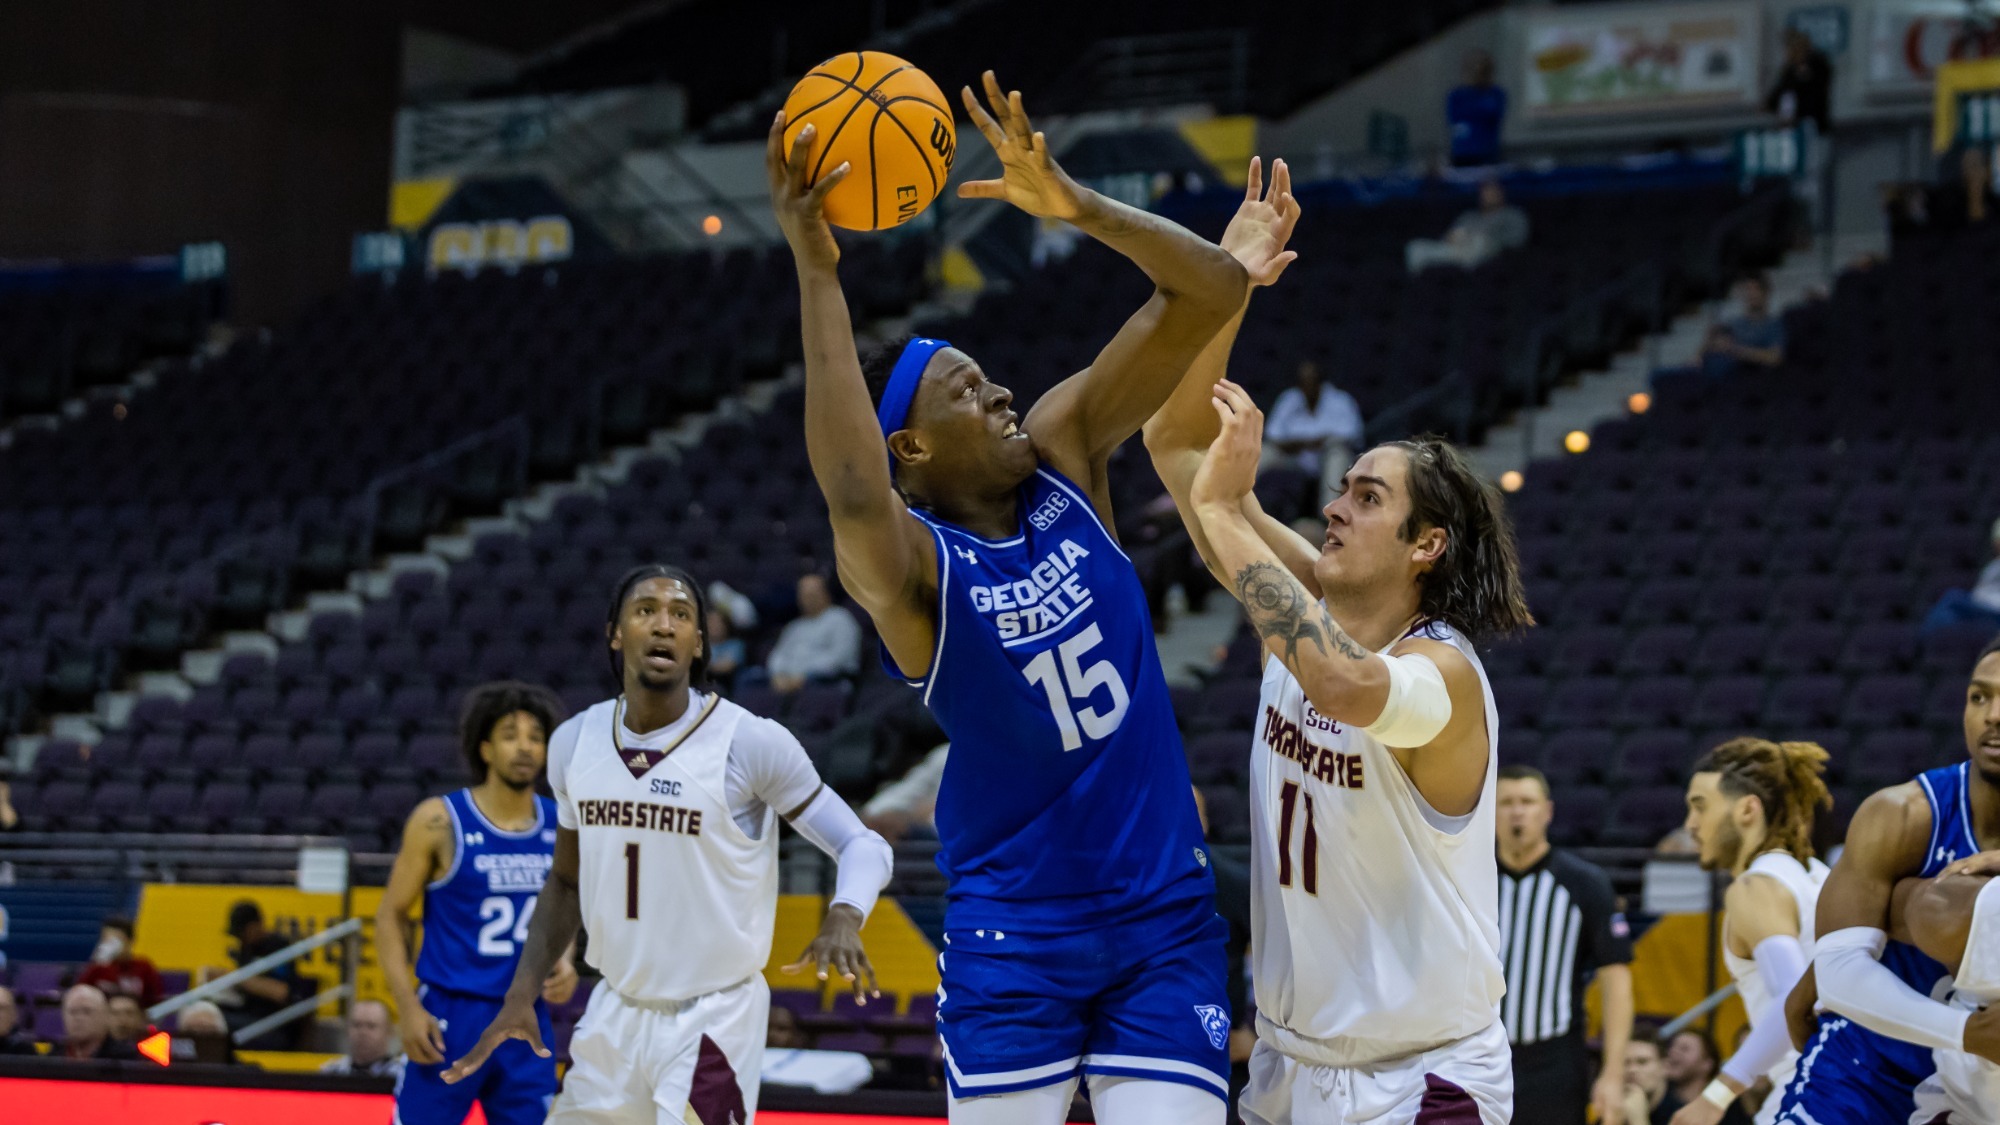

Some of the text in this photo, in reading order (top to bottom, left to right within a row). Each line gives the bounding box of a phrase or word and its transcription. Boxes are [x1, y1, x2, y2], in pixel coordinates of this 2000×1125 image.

[1028, 492, 1070, 531] SBC
[970, 539, 1090, 612] GEOGIA
[996, 572, 1091, 639] STATE
[1021, 621, 1131, 752] 15
[578, 800, 702, 836] TEXAS STATE
[650, 778, 682, 797] SBC
[1277, 778, 1319, 898] 11
[624, 842, 640, 921] 1
